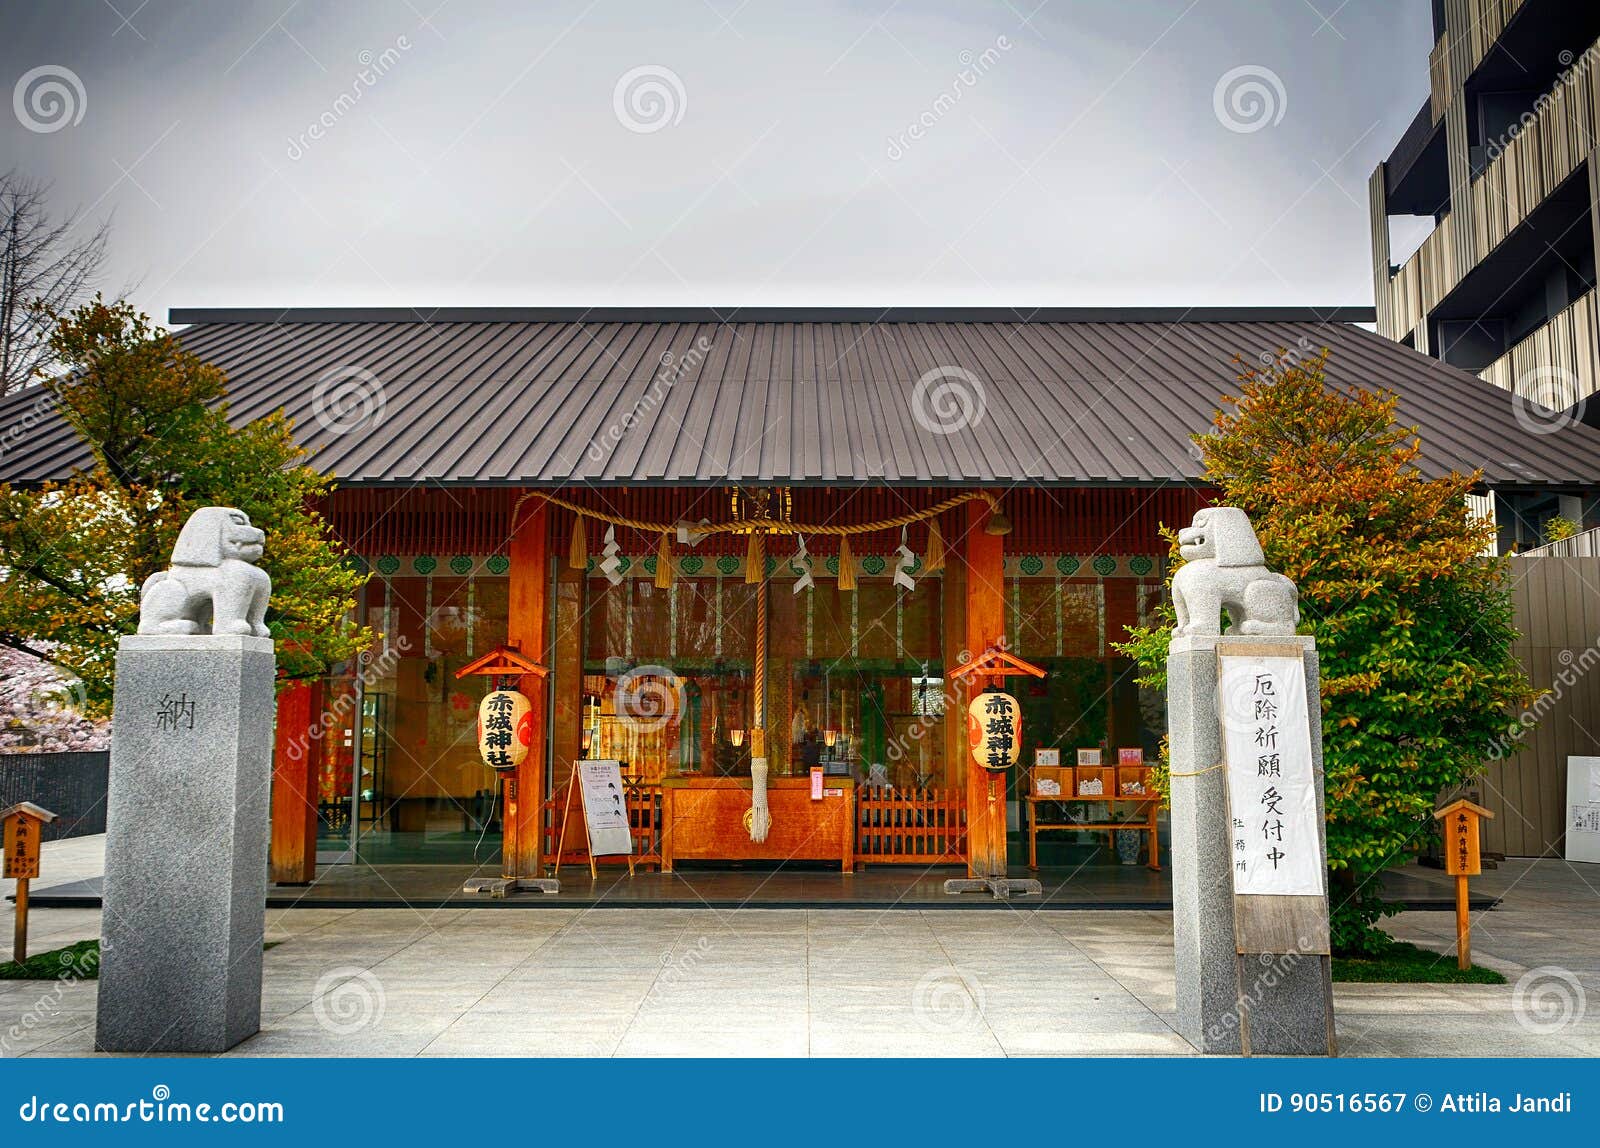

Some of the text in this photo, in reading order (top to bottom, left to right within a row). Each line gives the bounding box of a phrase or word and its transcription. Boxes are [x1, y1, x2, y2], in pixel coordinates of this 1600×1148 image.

[157, 693, 195, 730] 納
[484, 693, 514, 766] 赤城神社
[984, 695, 1014, 767] 赤城神社
[1253, 673, 1286, 870] 厄除祈願受付中
[1233, 818, 1247, 873] 社務所
